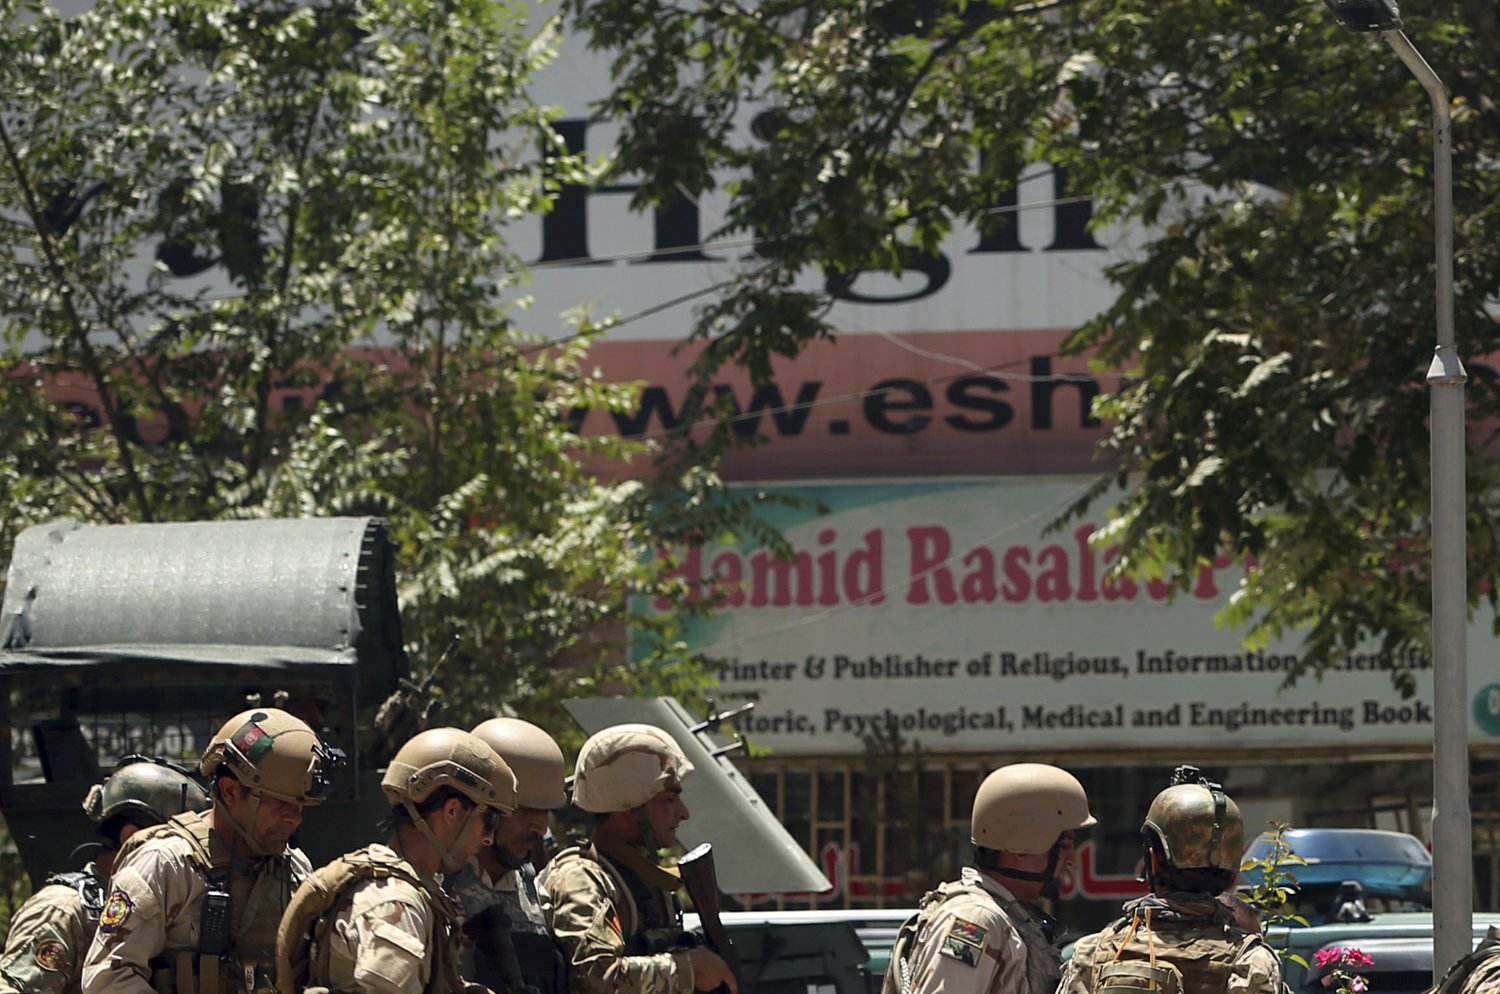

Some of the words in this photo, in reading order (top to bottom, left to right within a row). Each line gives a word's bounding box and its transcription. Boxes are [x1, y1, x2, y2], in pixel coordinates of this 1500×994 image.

[653, 526, 889, 610] Hamid
[713, 655, 797, 681] rinter
[804, 655, 825, 680] &
[834, 653, 958, 680] Publisher
[966, 652, 991, 678] of
[1000, 652, 1129, 680] Religious,
[720, 708, 816, 738] storic,
[824, 704, 1013, 737] Psychological,
[1022, 704, 1123, 731] Medical
[1132, 703, 1180, 728] and
[1189, 702, 1354, 731] Engineering
